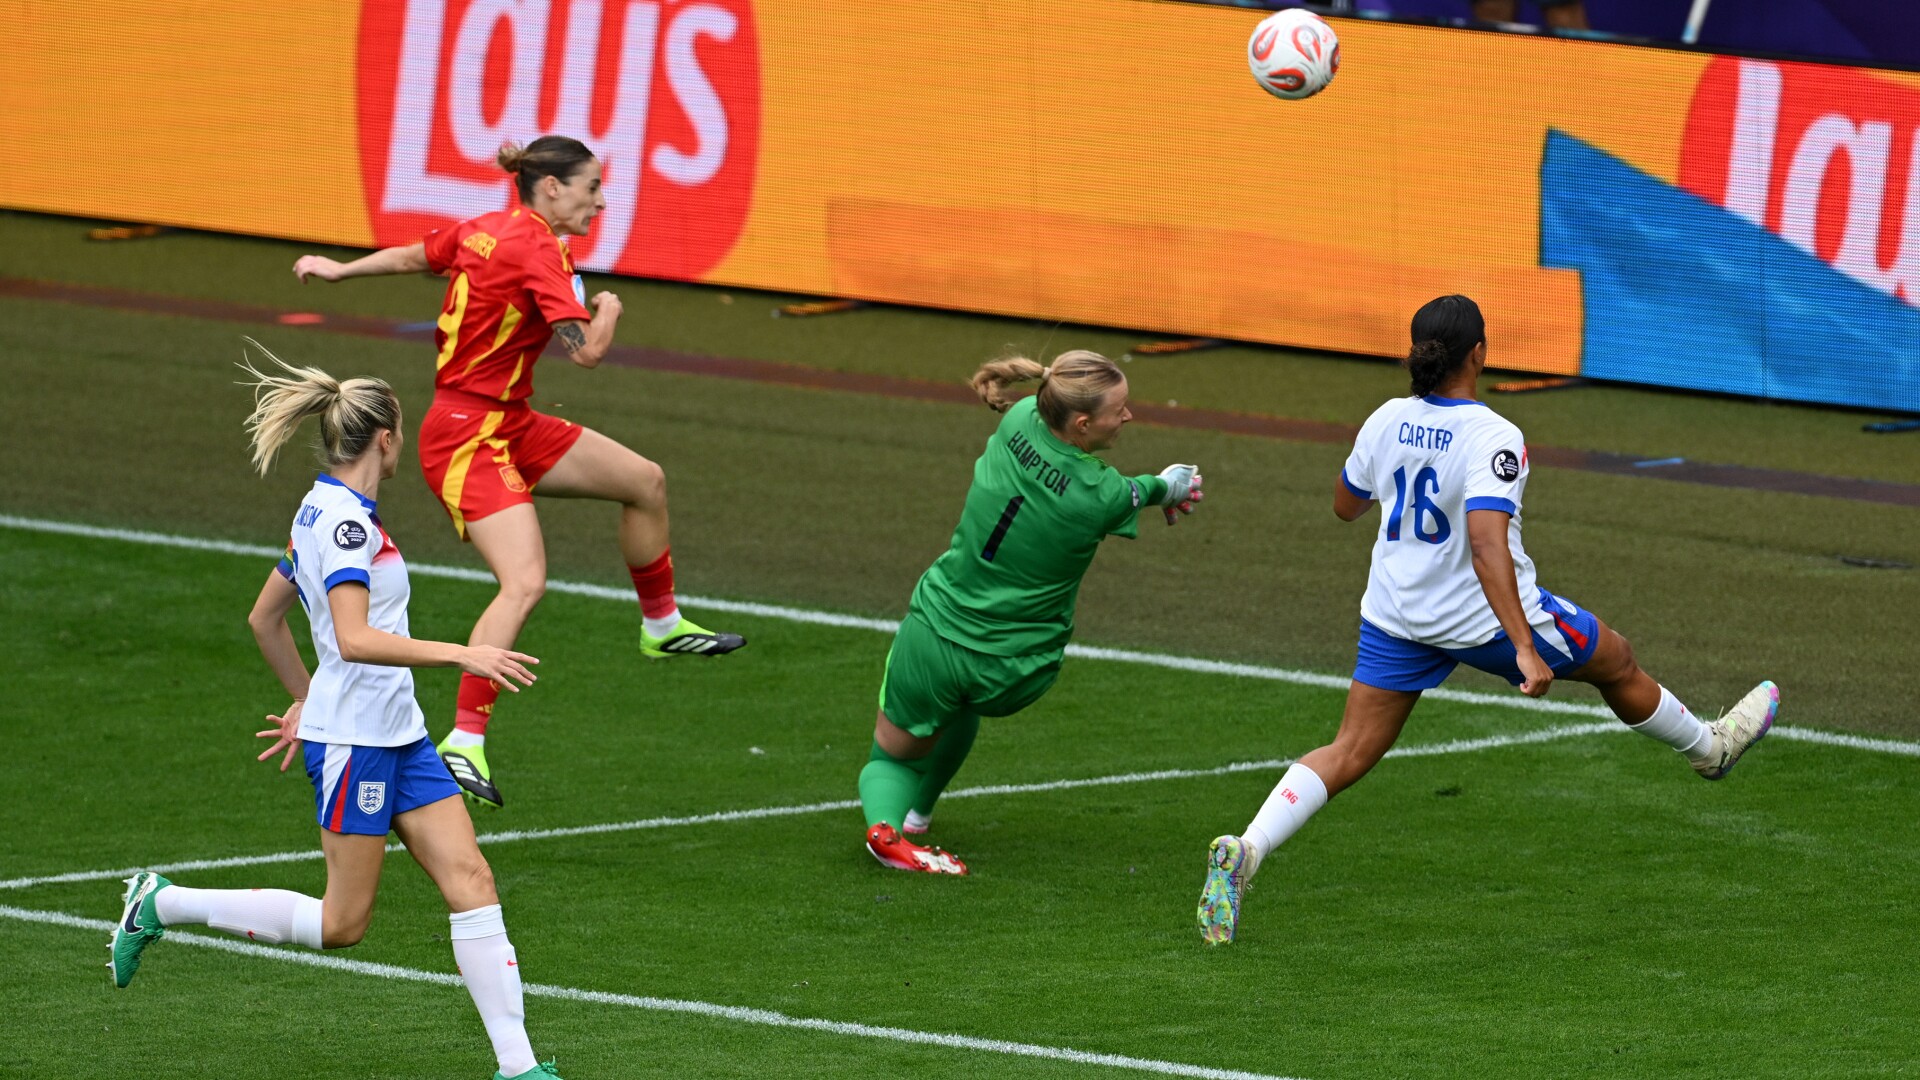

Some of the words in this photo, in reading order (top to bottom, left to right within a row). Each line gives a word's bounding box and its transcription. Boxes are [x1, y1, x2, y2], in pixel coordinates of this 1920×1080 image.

[381, 0, 738, 273] Lays
[1723, 57, 1920, 308] La
[1007, 431, 1072, 497] HAMPTON
[1398, 421, 1453, 452] CARTER
[980, 495, 1026, 562] 1
[1387, 465, 1452, 545] 16
[1281, 788, 1299, 805] ENG
